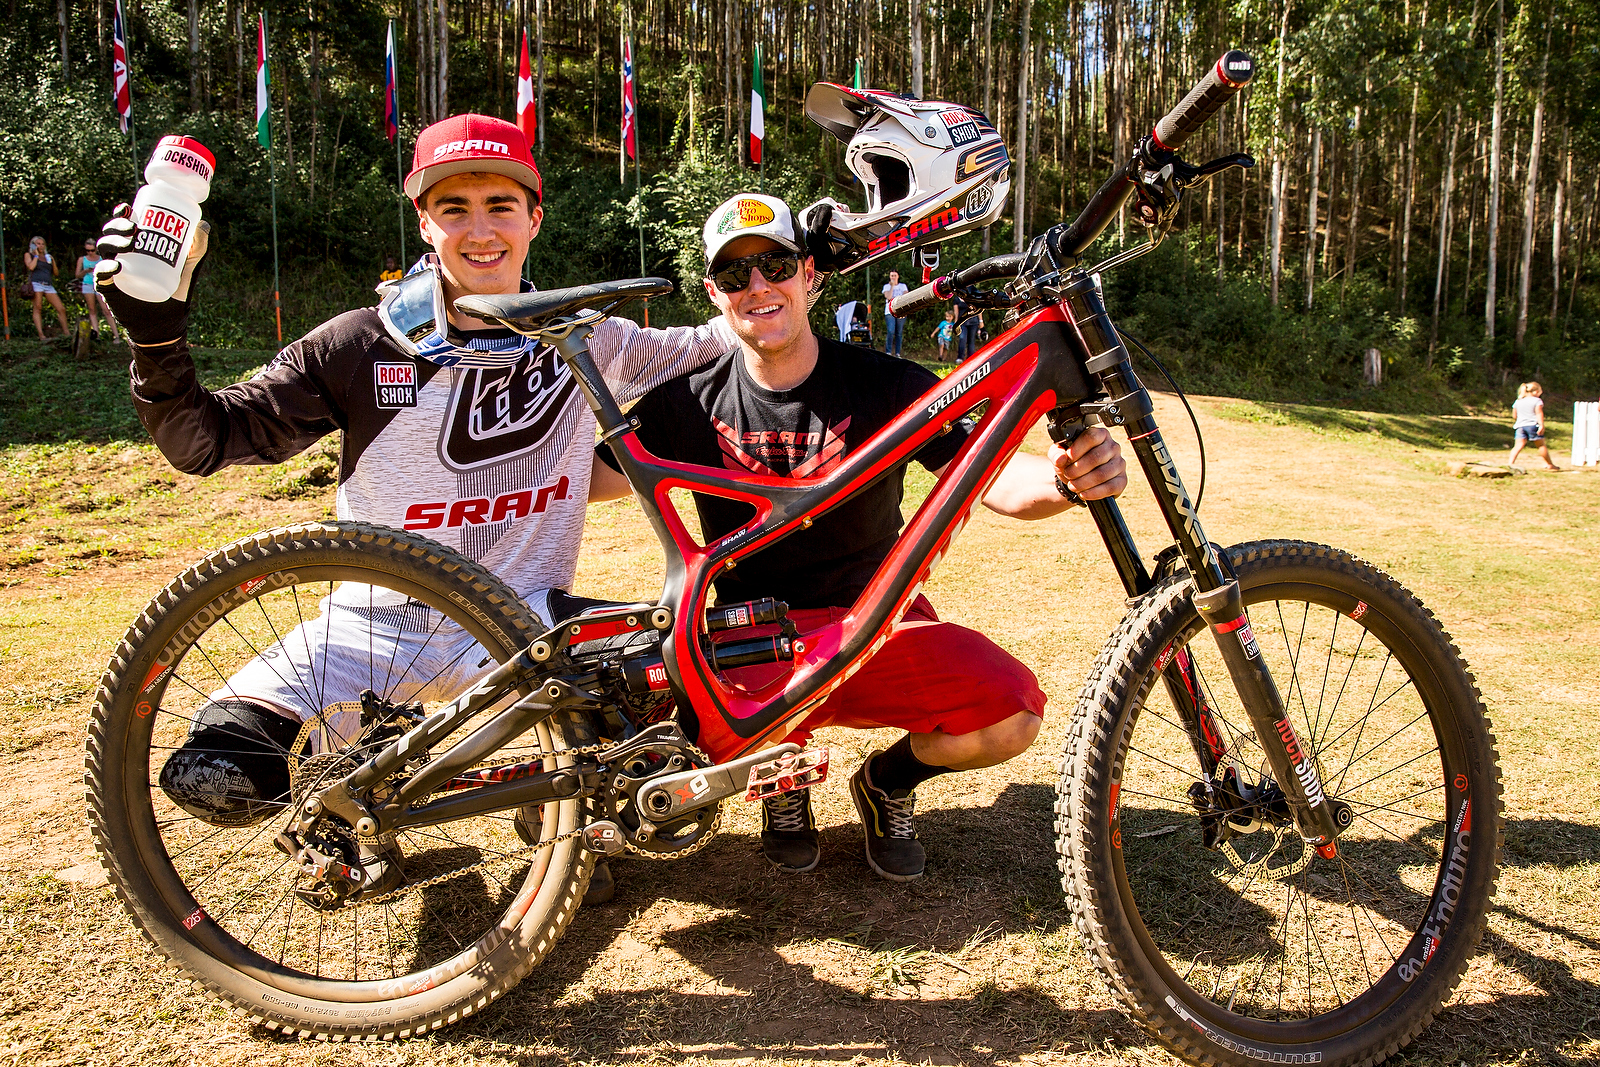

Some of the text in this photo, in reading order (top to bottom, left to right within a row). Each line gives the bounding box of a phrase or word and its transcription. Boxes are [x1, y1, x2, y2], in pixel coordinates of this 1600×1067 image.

[942, 110, 970, 126] ROCK
[951, 123, 978, 143] SHOX
[162, 149, 210, 182] OCKSHOX
[737, 200, 762, 209] Bass
[740, 207, 757, 216] Pro
[142, 208, 185, 240] ROCK
[740, 214, 771, 224] Shops
[134, 231, 179, 263] SHOX
[380, 366, 413, 384] ROCK
[381, 387, 413, 404] SHOX
[927, 361, 991, 420] SPECIALIZED
[741, 431, 821, 446] SRAM
[449, 590, 520, 652] BUTC
[1241, 626, 1255, 645] RO
[1246, 643, 1260, 658] SH
[648, 668, 669, 684] ROC
[1205, 1028, 1323, 1064] BUTCHER
